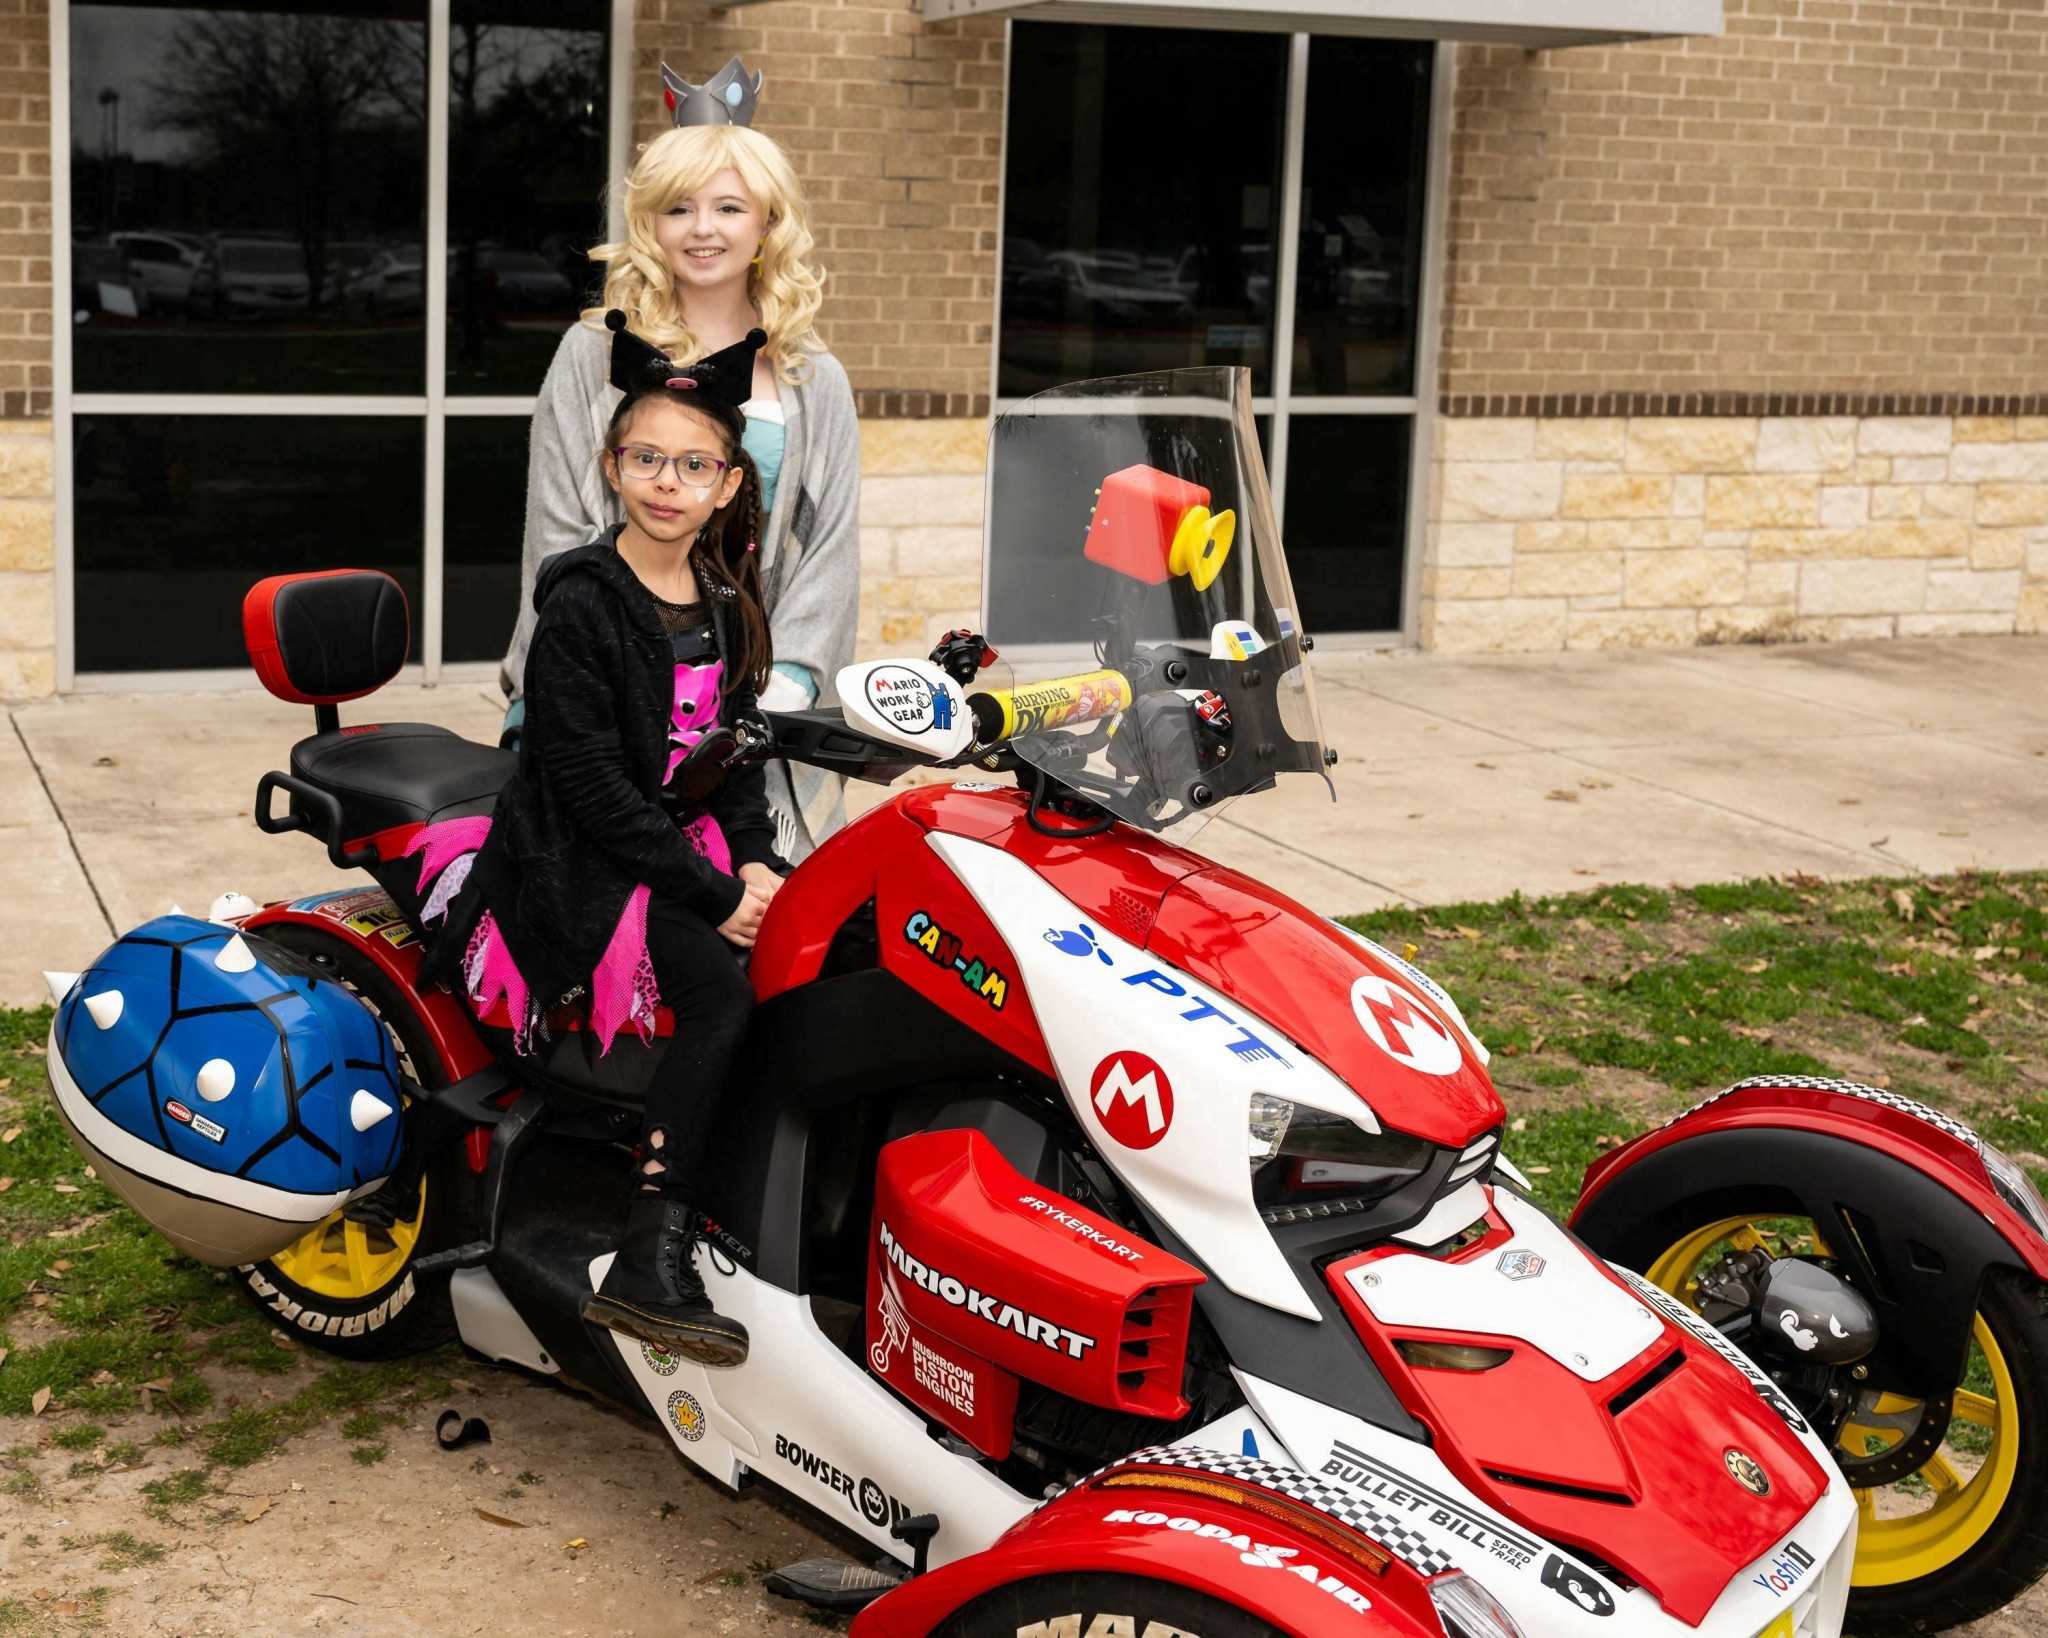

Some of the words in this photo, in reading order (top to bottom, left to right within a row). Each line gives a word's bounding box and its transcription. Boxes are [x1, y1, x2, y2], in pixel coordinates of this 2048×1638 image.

[876, 679, 920, 692] MARIO
[876, 694, 913, 708] WORK
[1011, 687, 1070, 711] BURNING
[893, 709, 924, 721] GEAR
[904, 910, 1009, 1010] CAN-AM
[1121, 969, 1294, 1069] PTT
[1018, 1196, 1144, 1261] #RYKERKART
[238, 1264, 416, 1337] MARIOKA
[912, 1337, 974, 1384] MUSHROOM
[912, 1349, 974, 1401] PISTON
[914, 1366, 975, 1417] ENGINES
[775, 1433, 859, 1513] BOWSER
[1319, 1458, 1428, 1513] BULLET
[1428, 1509, 1487, 1549] BILL
[1102, 1509, 1251, 1551] KOOPA
[1286, 1564, 1373, 1615] AIR
[1489, 1547, 1523, 1570] TRIAL
[1491, 1539, 1532, 1564] SPEED
[1752, 1553, 1805, 1598] Yoshi
